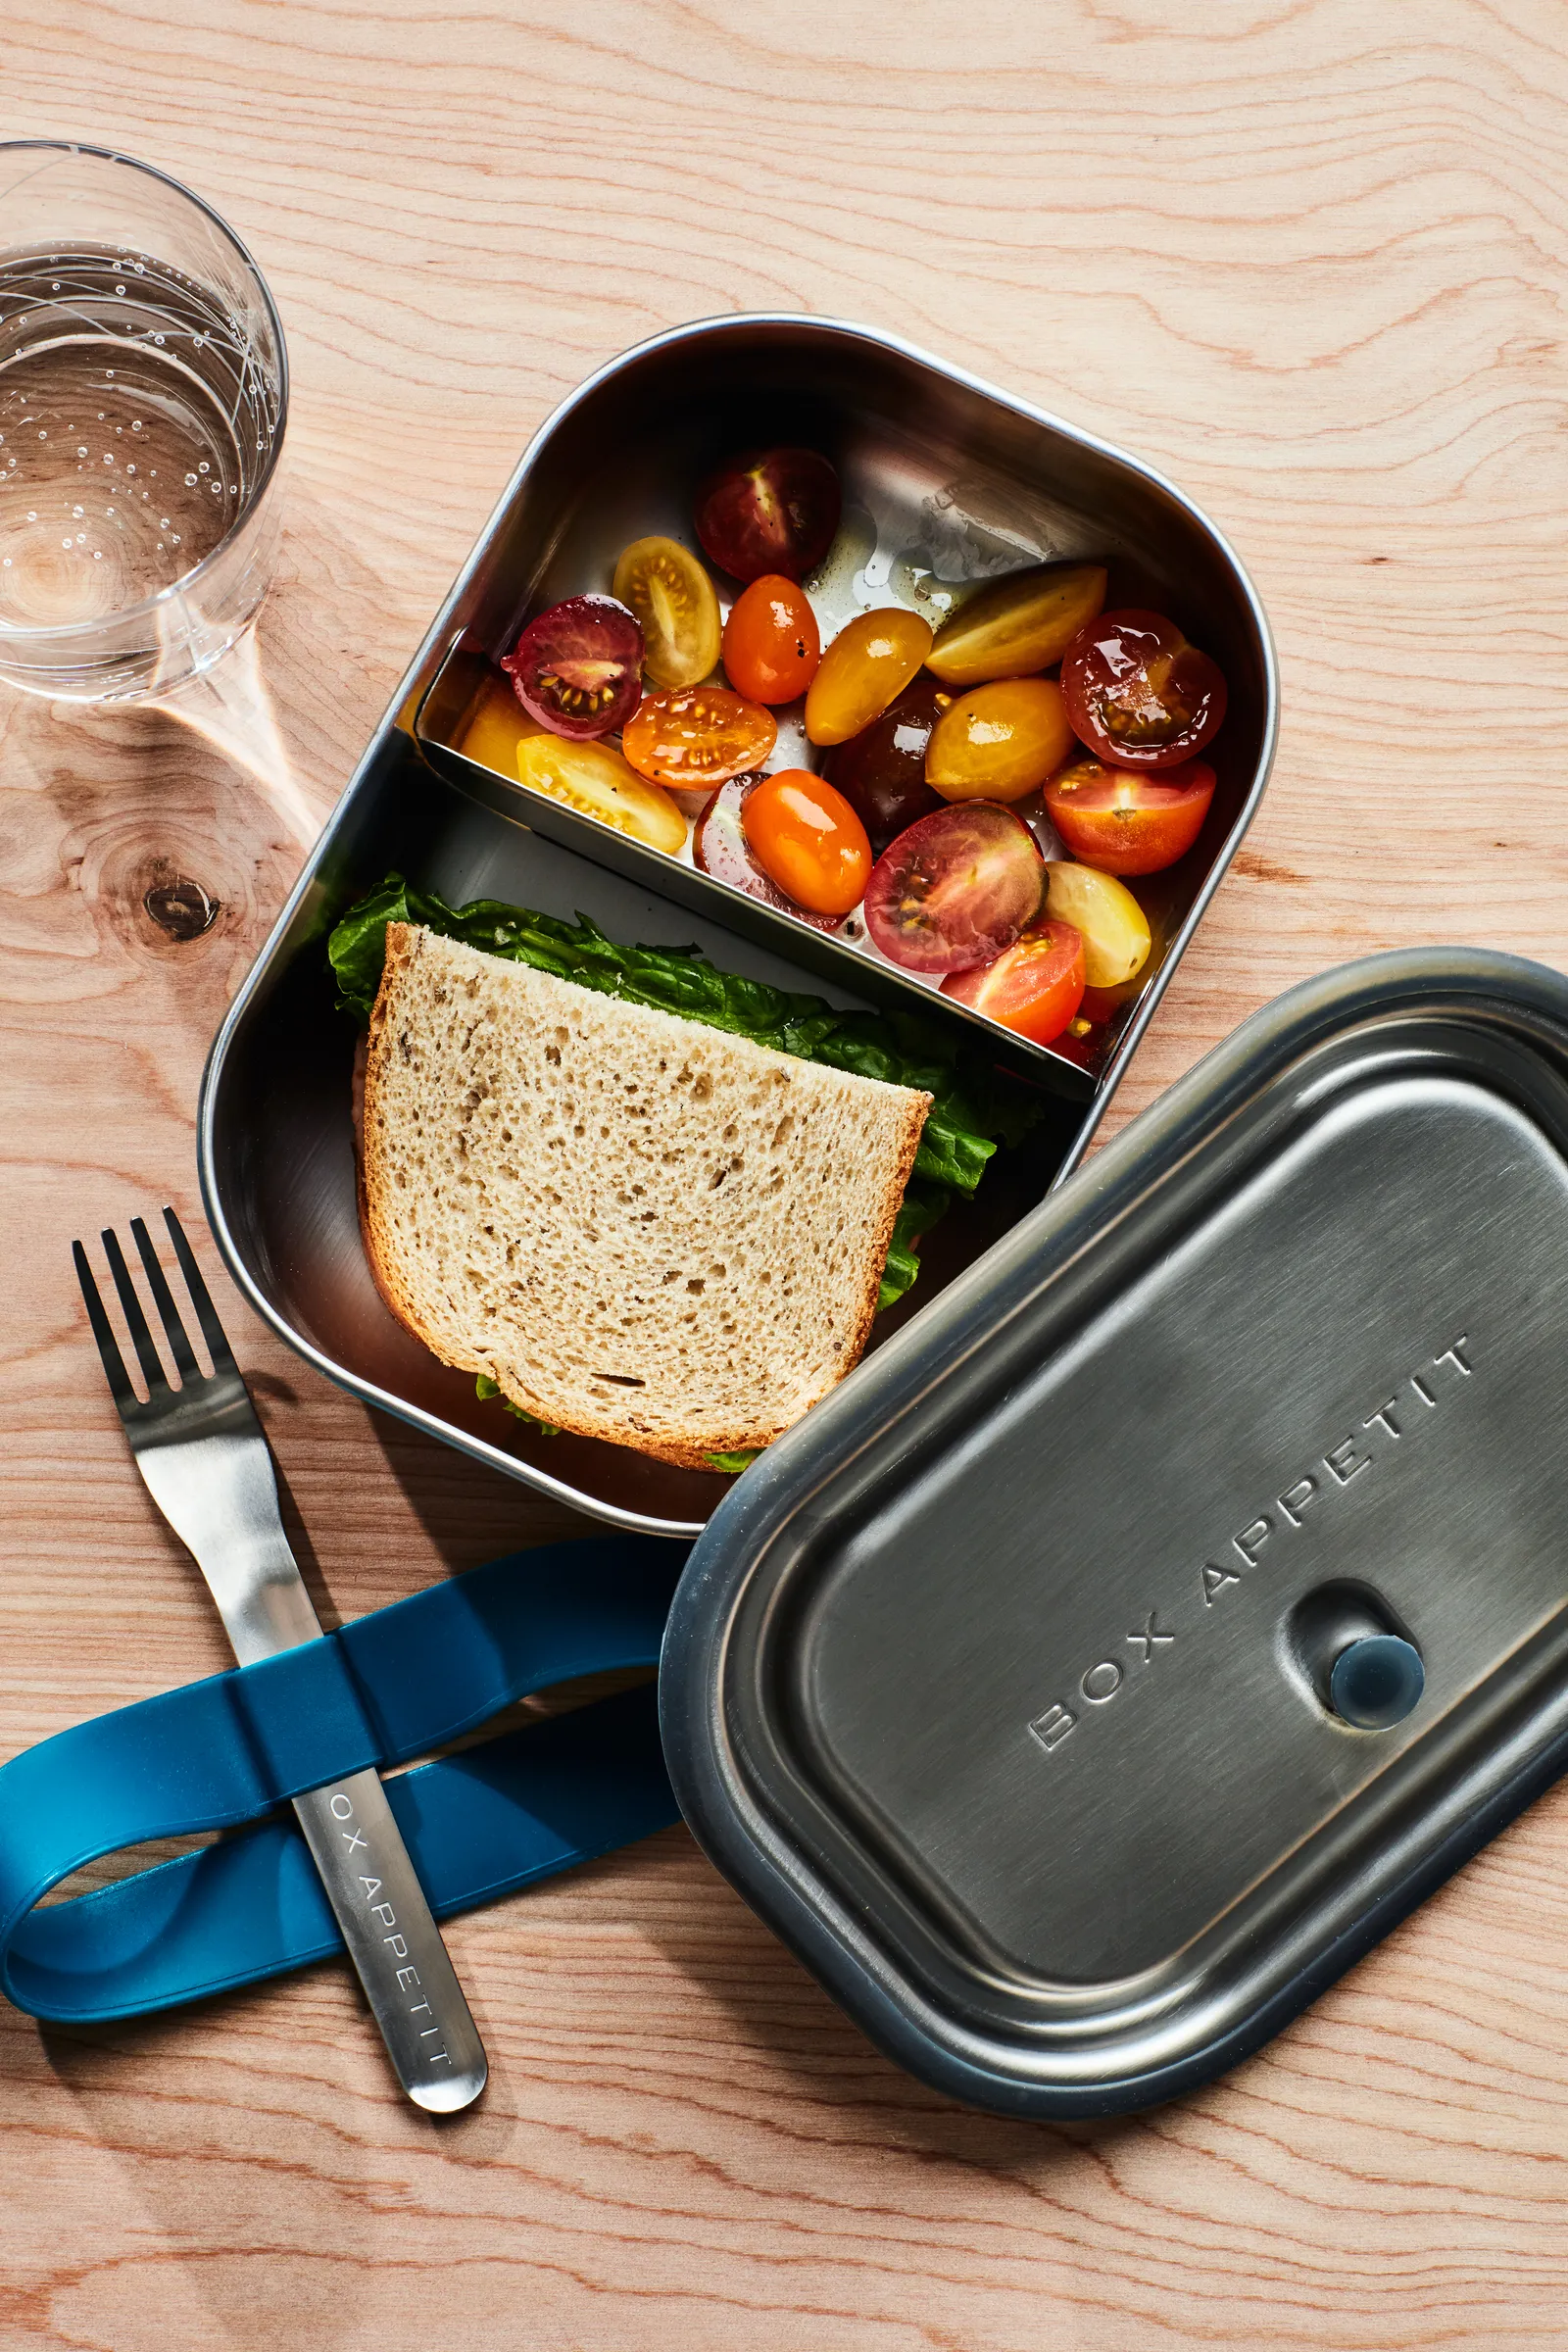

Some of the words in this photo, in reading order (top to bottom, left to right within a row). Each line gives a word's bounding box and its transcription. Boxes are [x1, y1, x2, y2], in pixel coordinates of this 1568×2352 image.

[1027, 1611, 1175, 1750] BOX
[1200, 1332, 1471, 1607] APPETIT
[329, 1792, 368, 1854] OX
[358, 1874, 453, 2066] APPETIT
